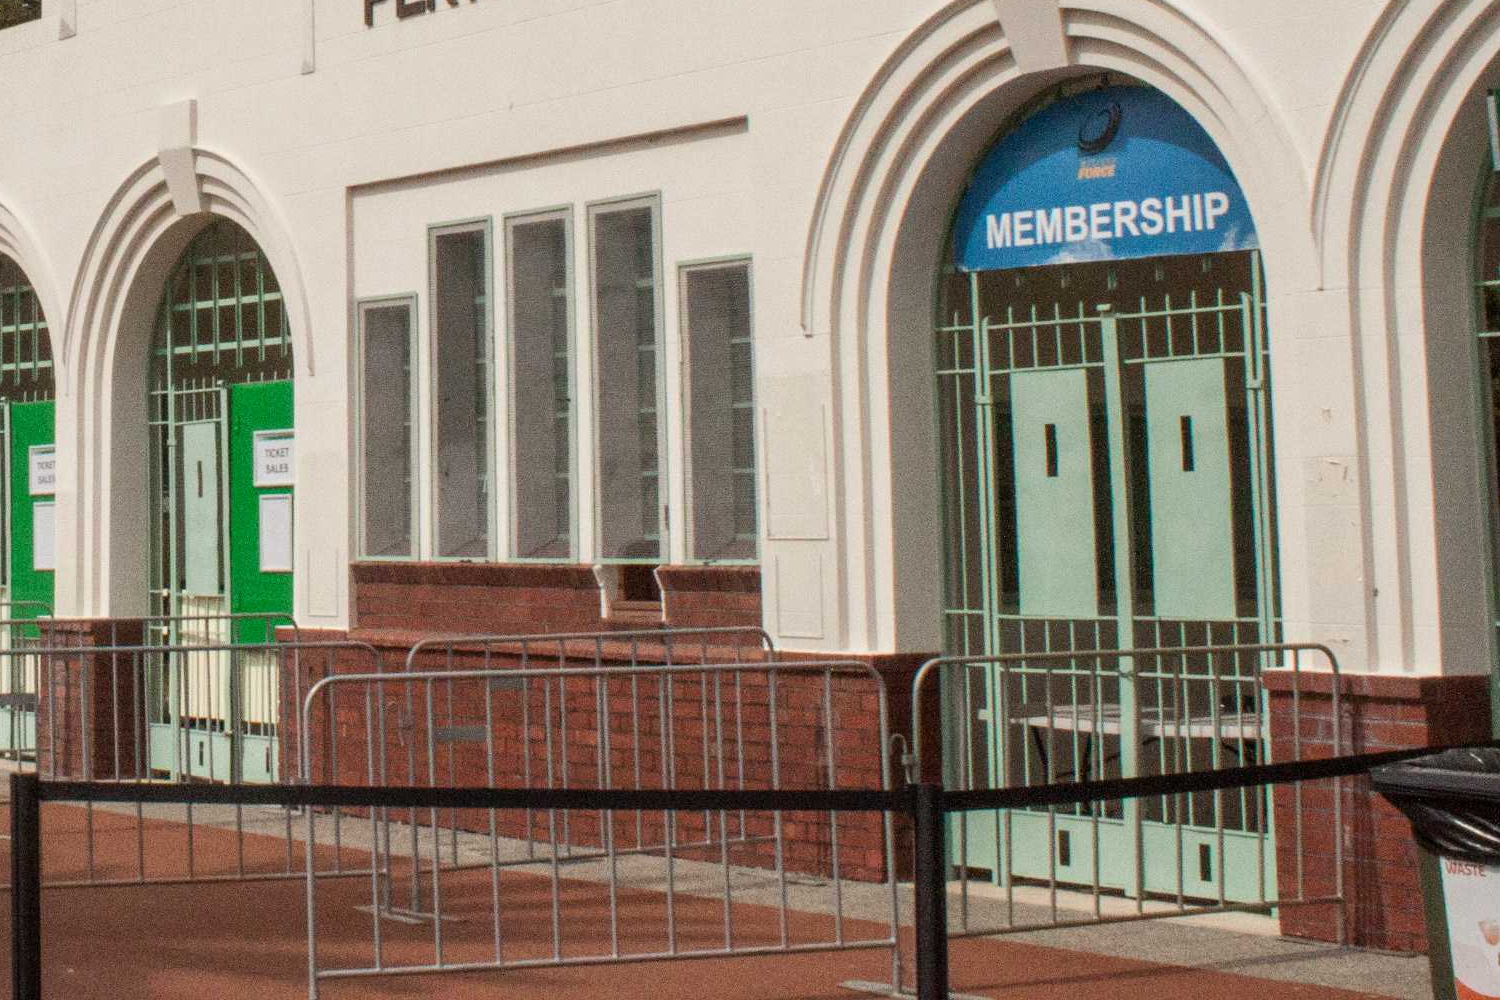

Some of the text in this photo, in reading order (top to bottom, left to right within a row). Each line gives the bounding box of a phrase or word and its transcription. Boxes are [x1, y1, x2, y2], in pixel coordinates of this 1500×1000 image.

[986, 191, 1231, 249] MEMBERSHIP
[265, 448, 290, 458] TICKET
[266, 464, 289, 474] SALES
[1445, 861, 1487, 877] WASTE
